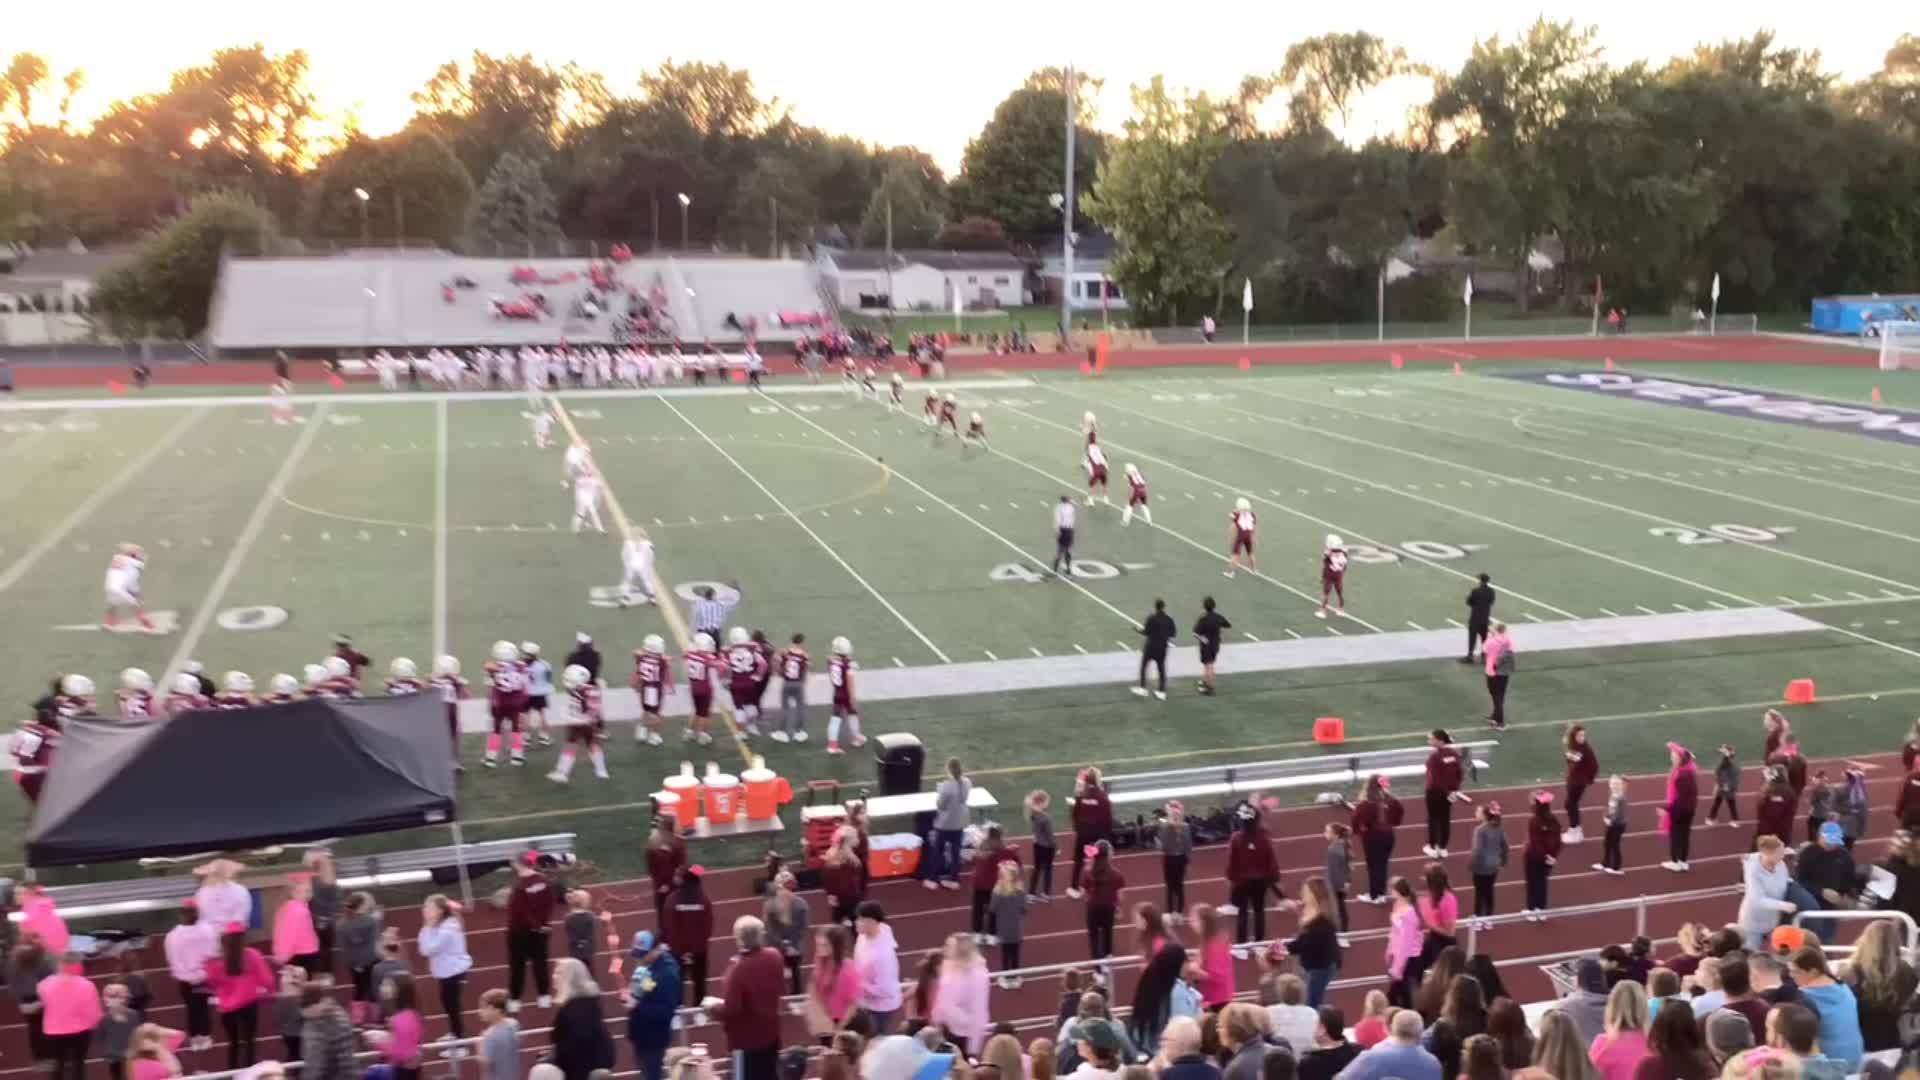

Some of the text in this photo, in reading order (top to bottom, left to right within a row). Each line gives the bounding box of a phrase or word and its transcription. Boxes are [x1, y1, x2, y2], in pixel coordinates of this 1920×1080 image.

[1649, 523, 1777, 545] 20
[1346, 541, 1465, 565] 30
[990, 560, 1120, 583] 40
